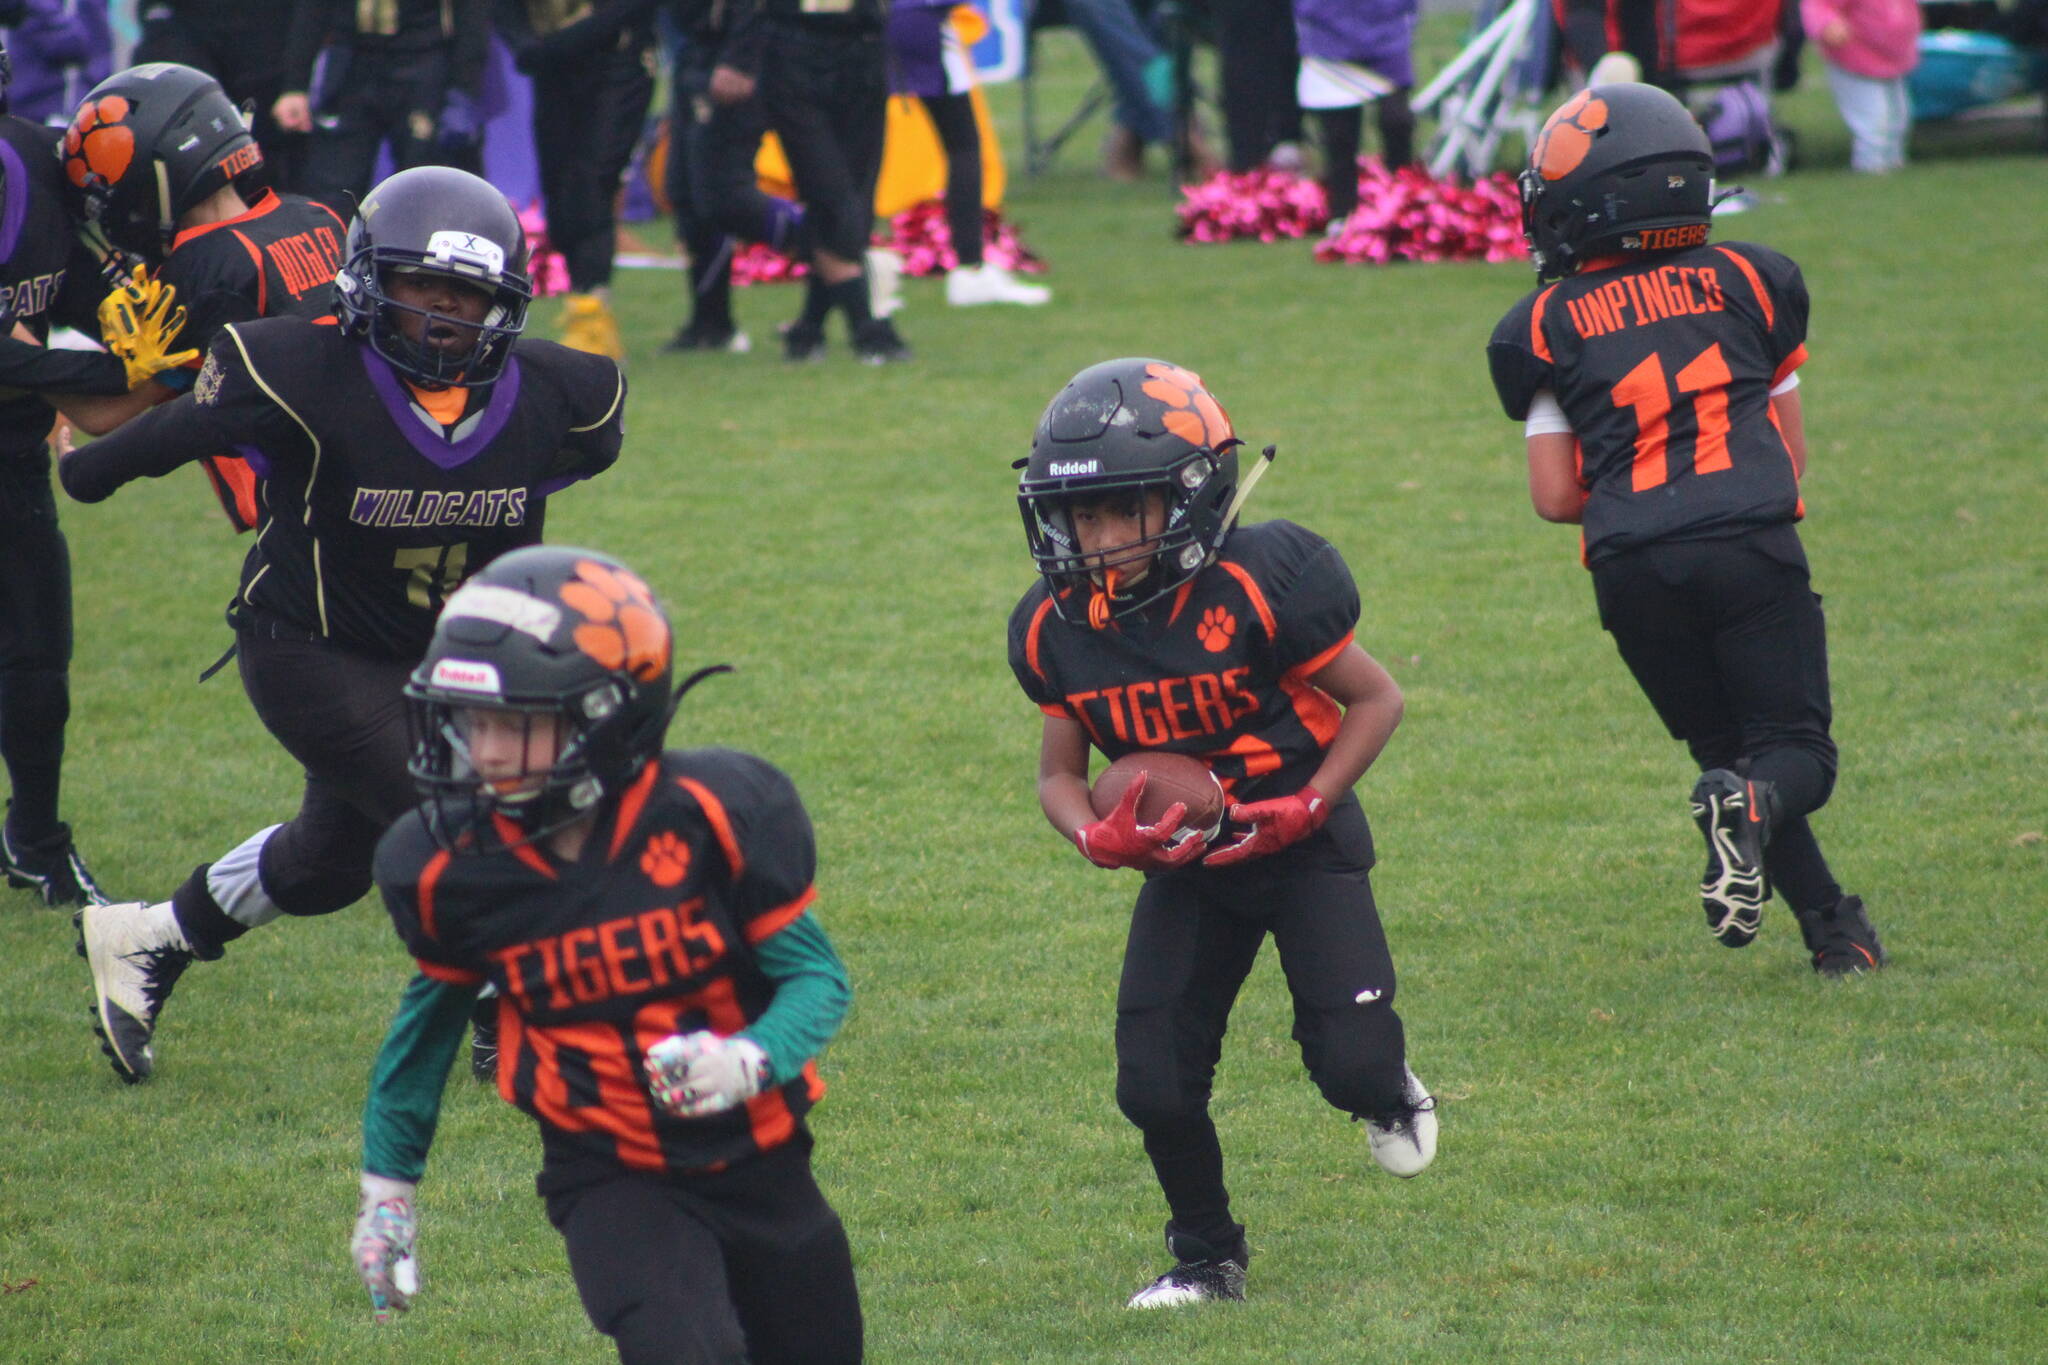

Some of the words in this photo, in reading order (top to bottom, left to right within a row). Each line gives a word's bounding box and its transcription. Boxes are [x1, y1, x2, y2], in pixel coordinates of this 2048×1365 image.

[1640, 224, 1708, 250] TIGERS
[1610, 341, 1734, 493] 11
[1050, 460, 1098, 476] Riddell
[349, 487, 527, 527] WILDCATS
[1066, 666, 1260, 748] TIGERS
[488, 898, 726, 1012] TIGERS
